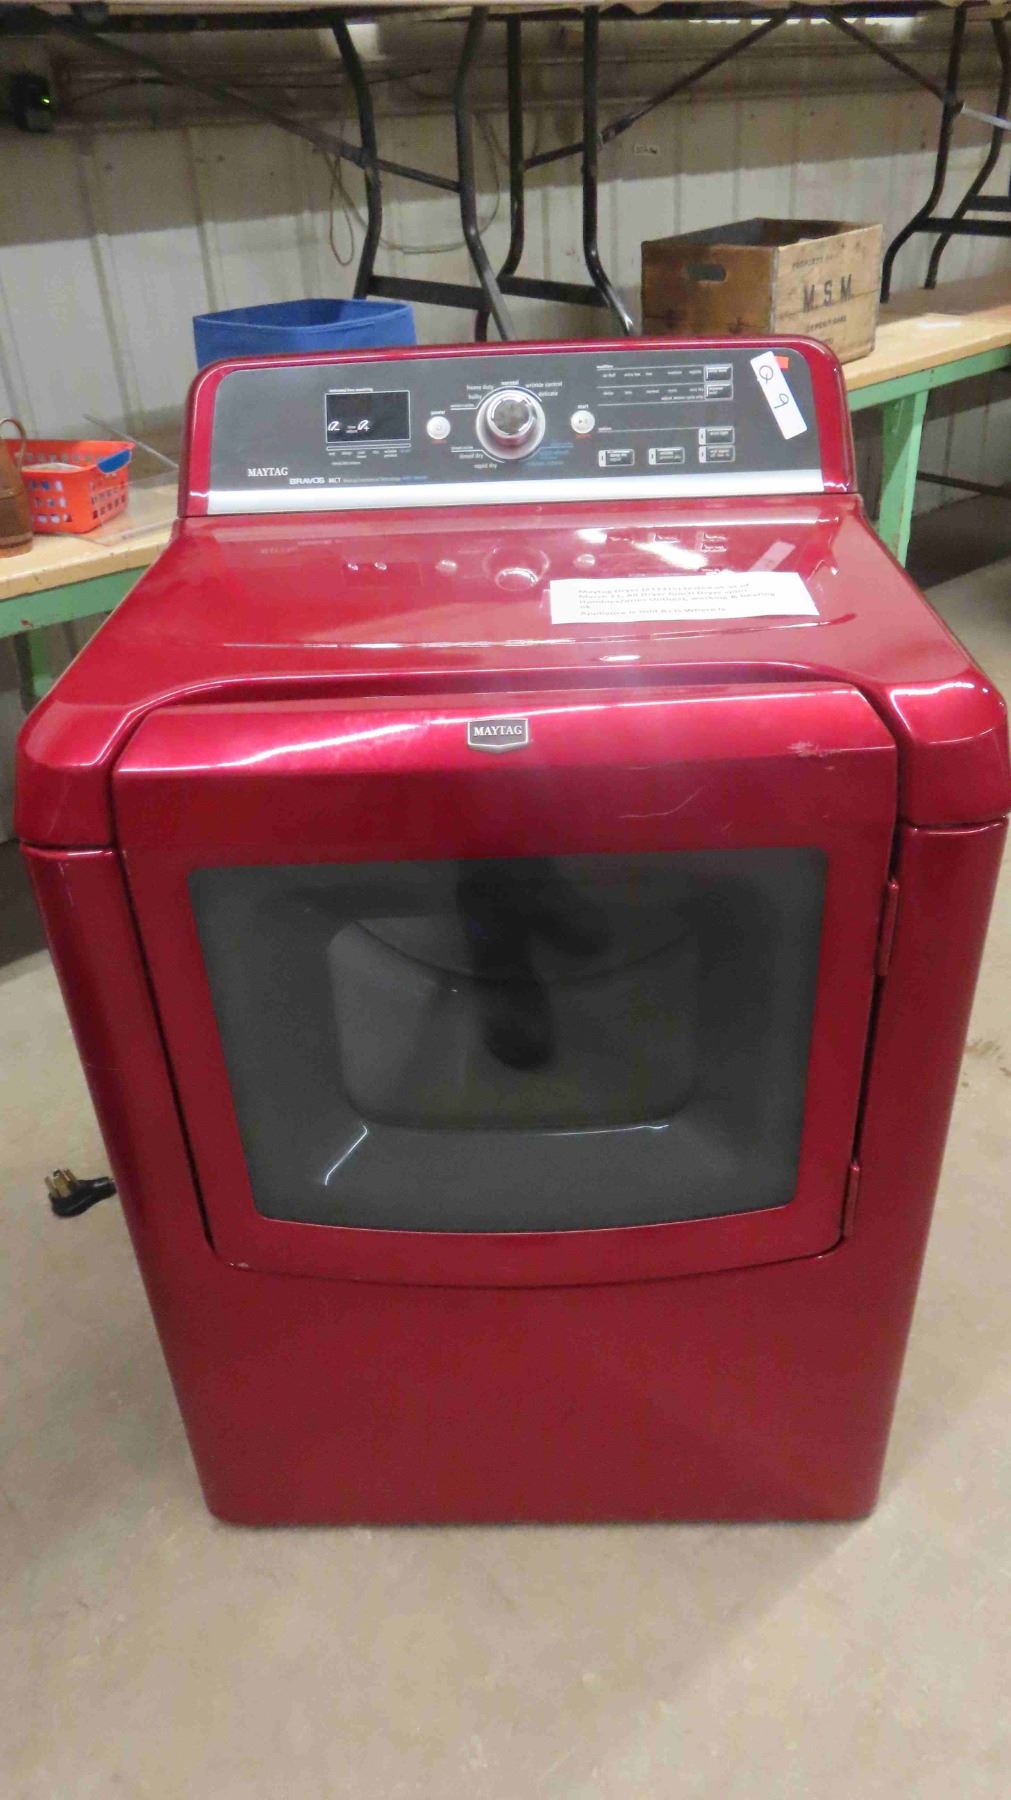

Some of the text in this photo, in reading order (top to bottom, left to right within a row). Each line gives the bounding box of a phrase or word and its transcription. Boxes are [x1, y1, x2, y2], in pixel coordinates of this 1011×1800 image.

[248, 467, 289, 477] MAYTAG
[289, 477, 326, 485] BRAVOS
[474, 725, 522, 736] MAYTAG
